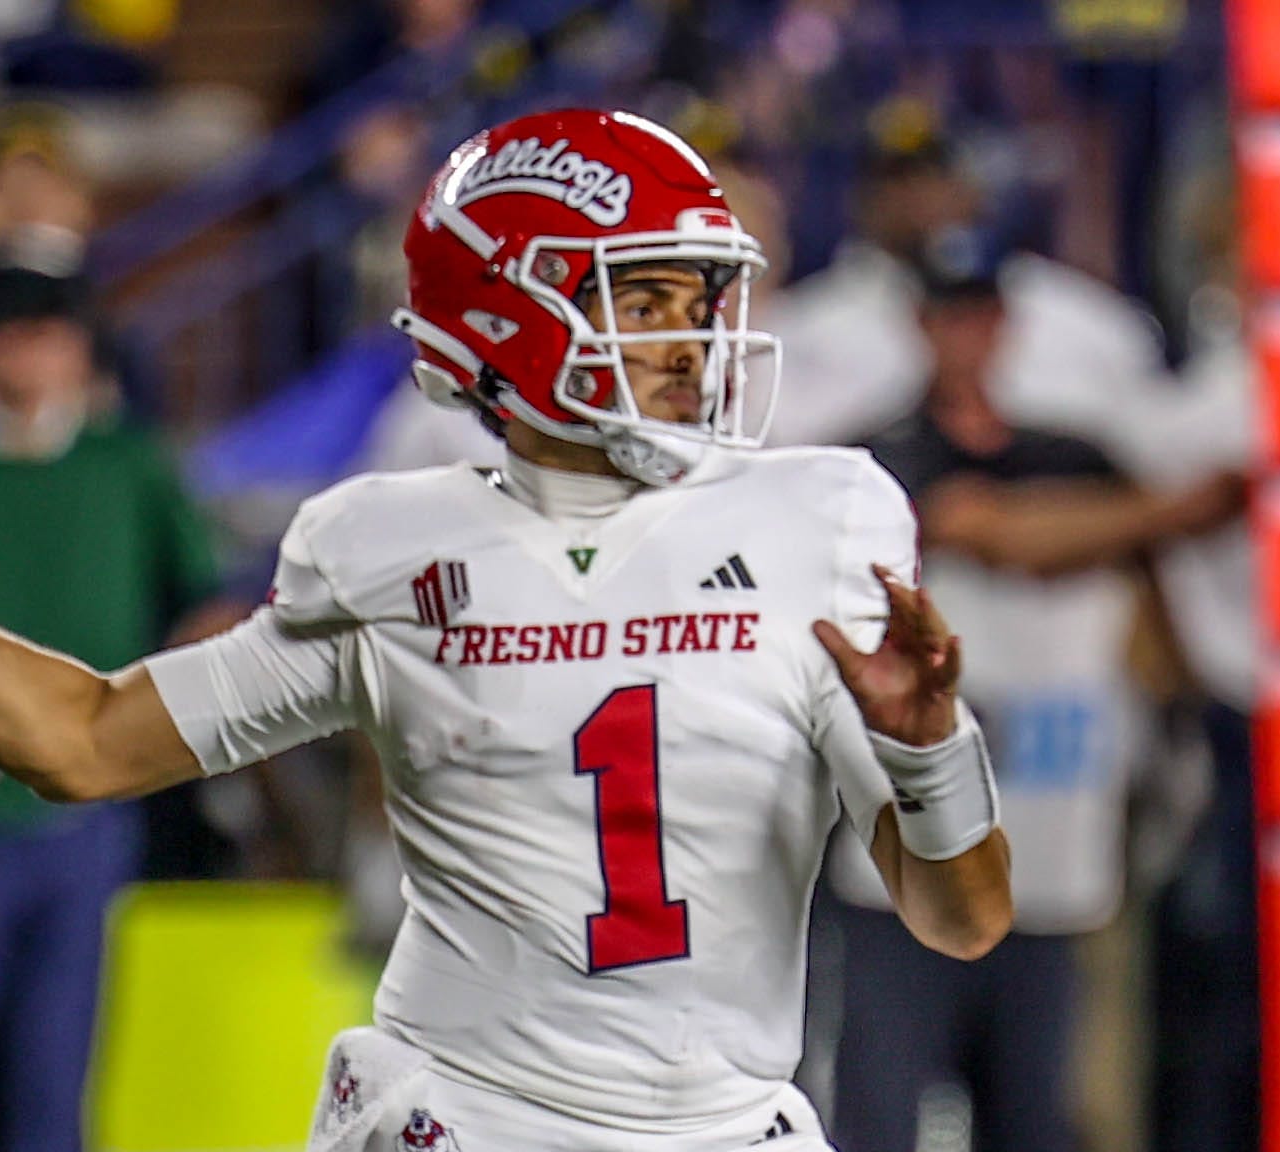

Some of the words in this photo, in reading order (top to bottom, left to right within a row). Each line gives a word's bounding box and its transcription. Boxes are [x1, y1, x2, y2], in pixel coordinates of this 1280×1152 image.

[566, 548, 598, 574] V
[435, 620, 607, 667] FRESNO
[623, 613, 760, 656] STATE
[574, 683, 691, 975] 1
